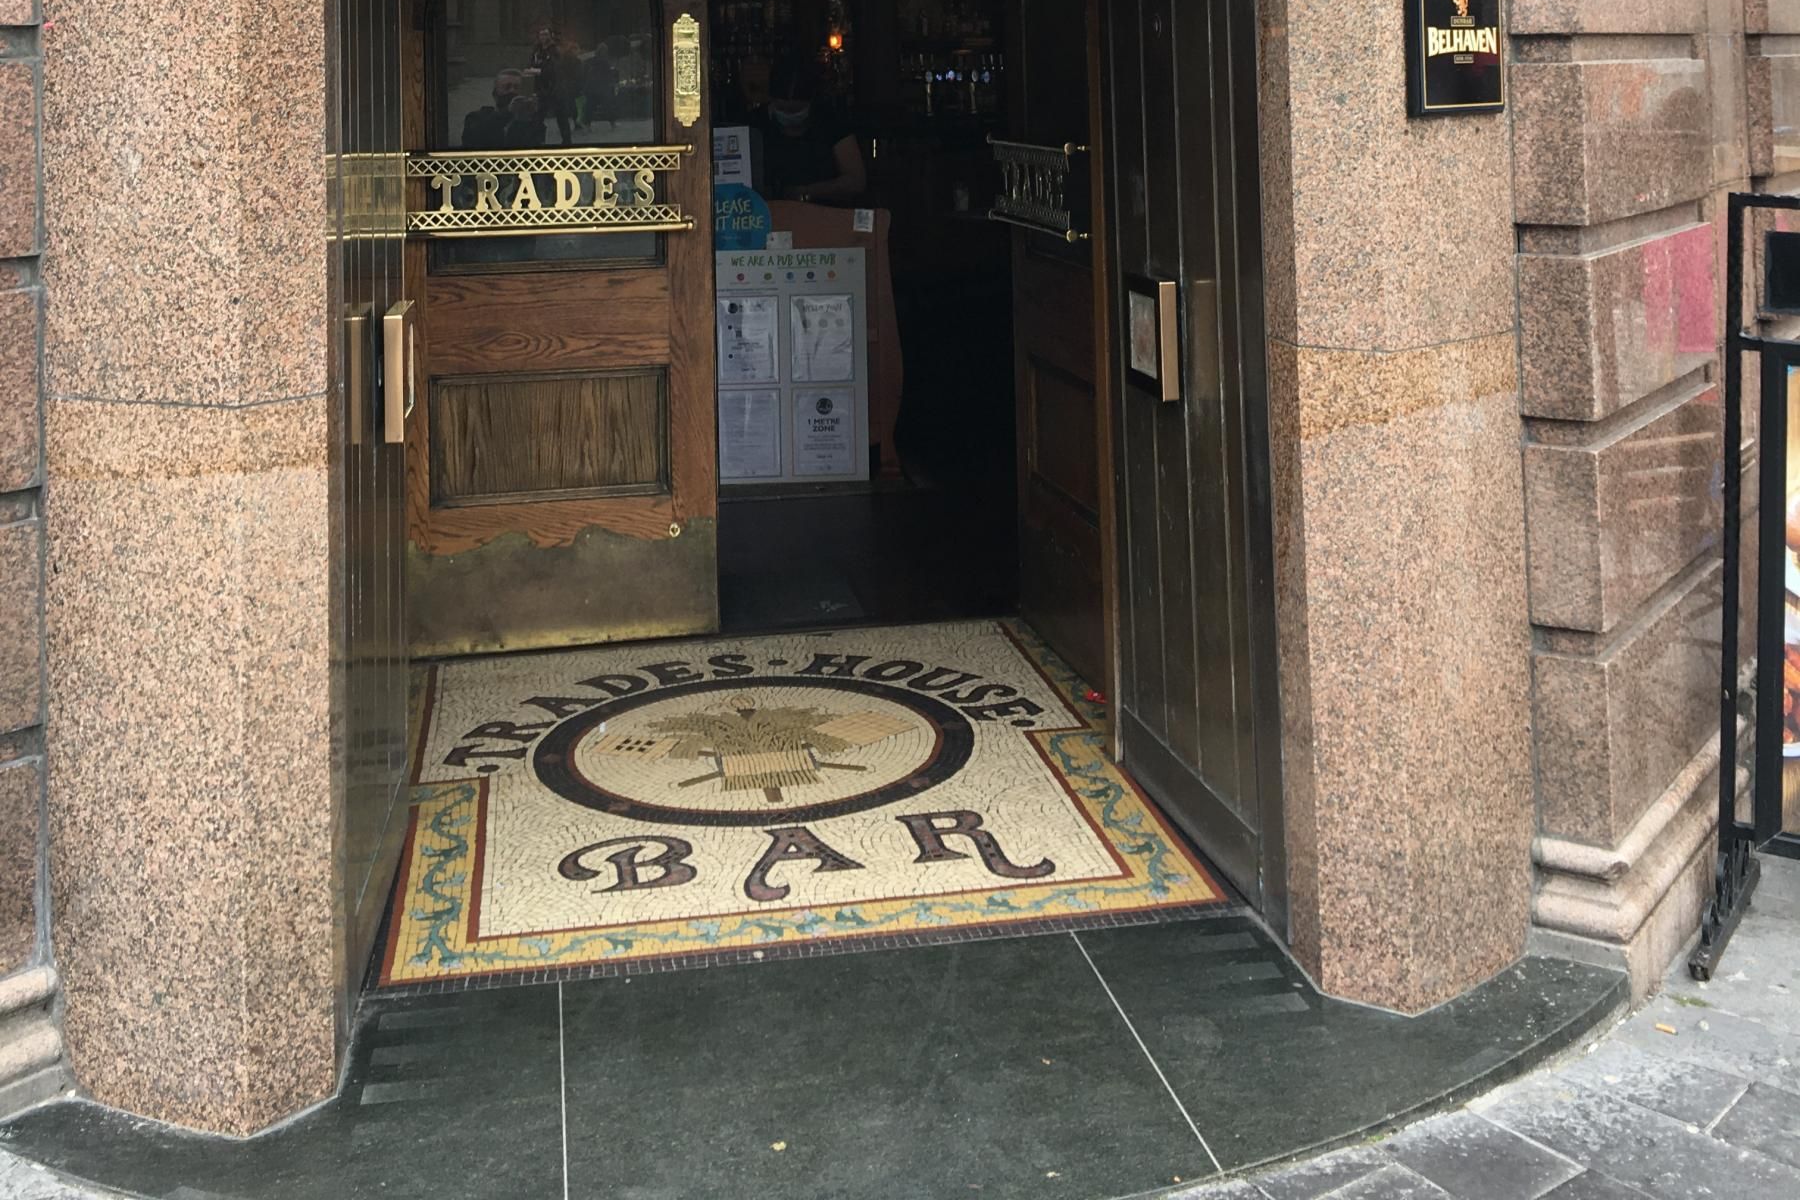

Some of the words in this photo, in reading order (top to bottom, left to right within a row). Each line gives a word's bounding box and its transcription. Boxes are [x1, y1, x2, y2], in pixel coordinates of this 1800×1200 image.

[1427, 26, 1498, 57] BELHAVEN
[431, 168, 655, 214] TRADES
[716, 197, 752, 215] LEASE
[732, 215, 764, 231] HERE
[731, 256, 745, 267] WE
[747, 256, 764, 266] ARE
[767, 255, 775, 266] A
[796, 253, 816, 267] SAFE
[814, 417, 840, 425] METRE
[444, 652, 755, 766] TRADES
[799, 651, 1045, 726] HOUSE
[558, 809, 1056, 902] BAR
